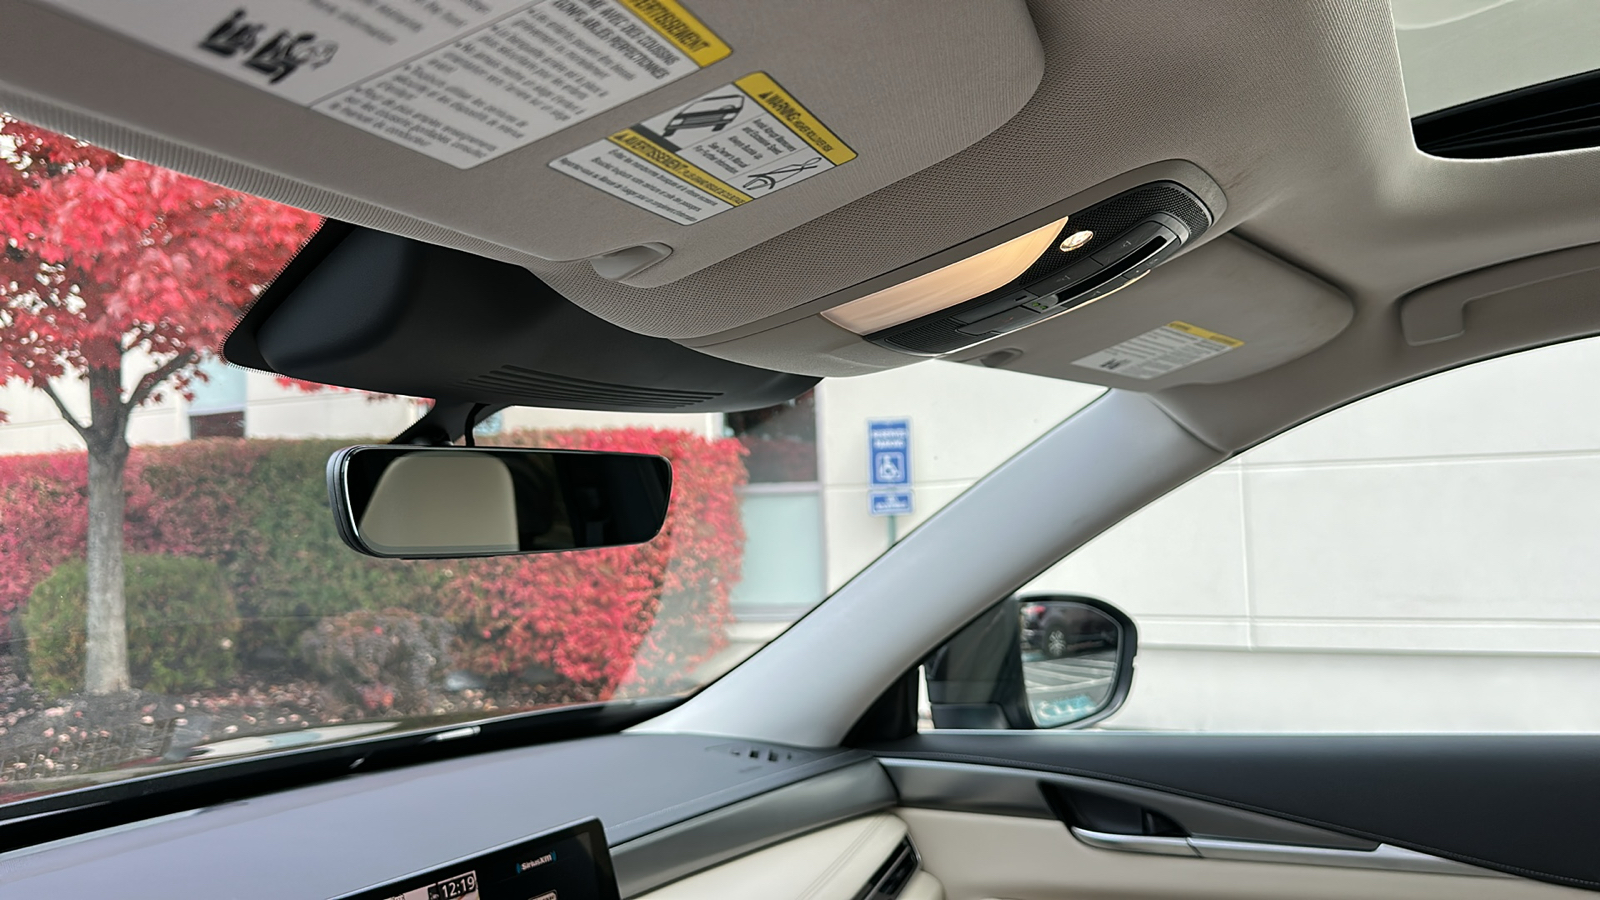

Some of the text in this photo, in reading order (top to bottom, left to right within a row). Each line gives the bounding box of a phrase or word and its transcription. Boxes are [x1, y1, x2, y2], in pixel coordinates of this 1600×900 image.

[596, 6, 633, 28] AVEC
[635, 35, 682, 66] COUSSINS
[441, 875, 475, 899] 12:19
